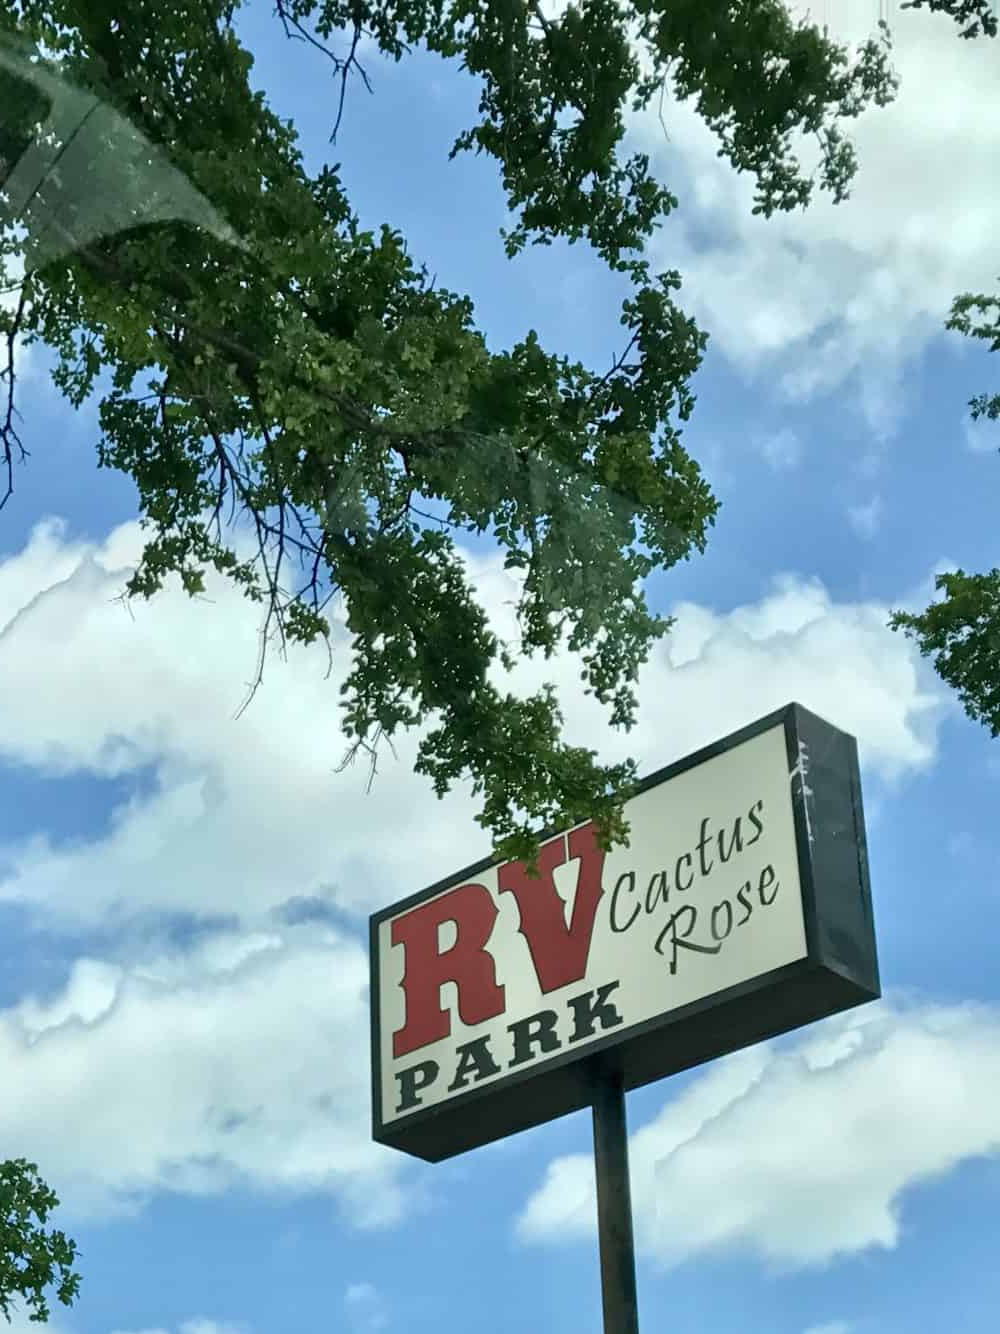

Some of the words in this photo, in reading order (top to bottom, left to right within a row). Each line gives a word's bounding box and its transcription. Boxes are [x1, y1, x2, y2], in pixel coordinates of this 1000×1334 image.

[609, 799, 764, 933] Cactus
[655, 863, 780, 975] Rose
[391, 821, 606, 1059] RV
[395, 980, 624, 1114] PARK
